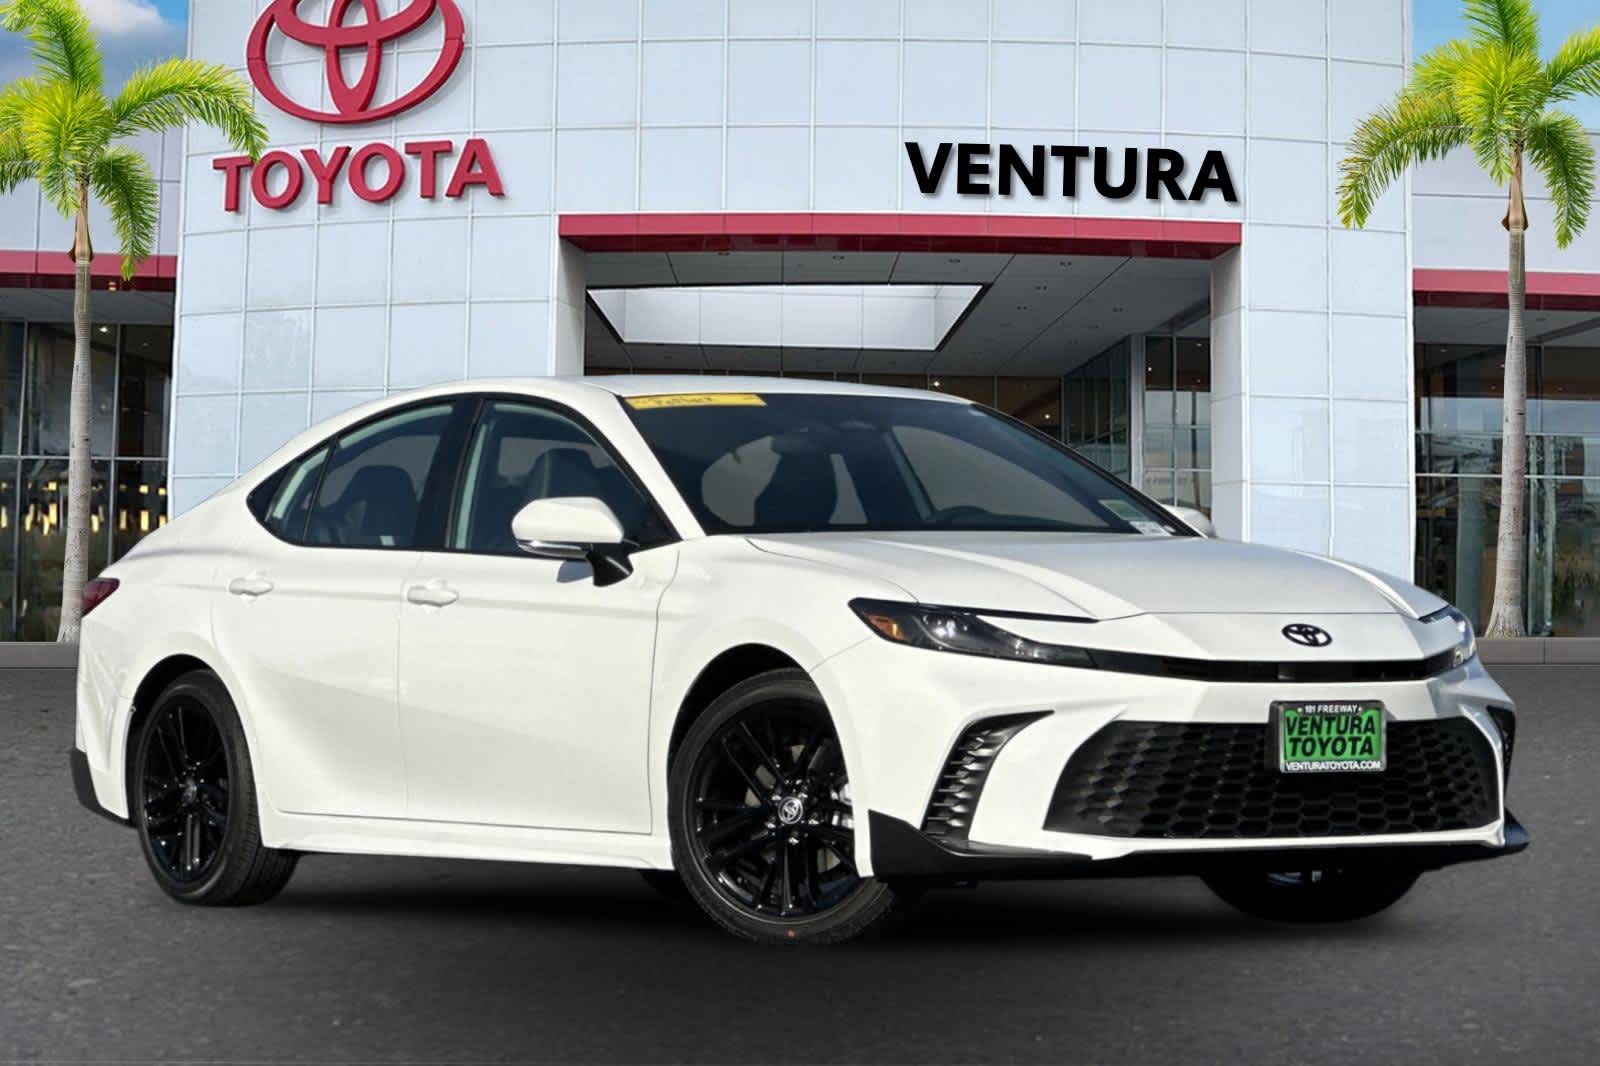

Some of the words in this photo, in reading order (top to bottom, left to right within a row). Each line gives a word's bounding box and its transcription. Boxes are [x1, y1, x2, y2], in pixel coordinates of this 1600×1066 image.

[213, 139, 505, 212] TOYOTA
[905, 142, 1238, 202] VENTURA
[1317, 704, 1357, 713] FREEWAY
[1286, 716, 1376, 736] VENTURA
[1289, 736, 1373, 757] TOYOTA
[1286, 761, 1381, 770] VENTURATOYOTA.COM
